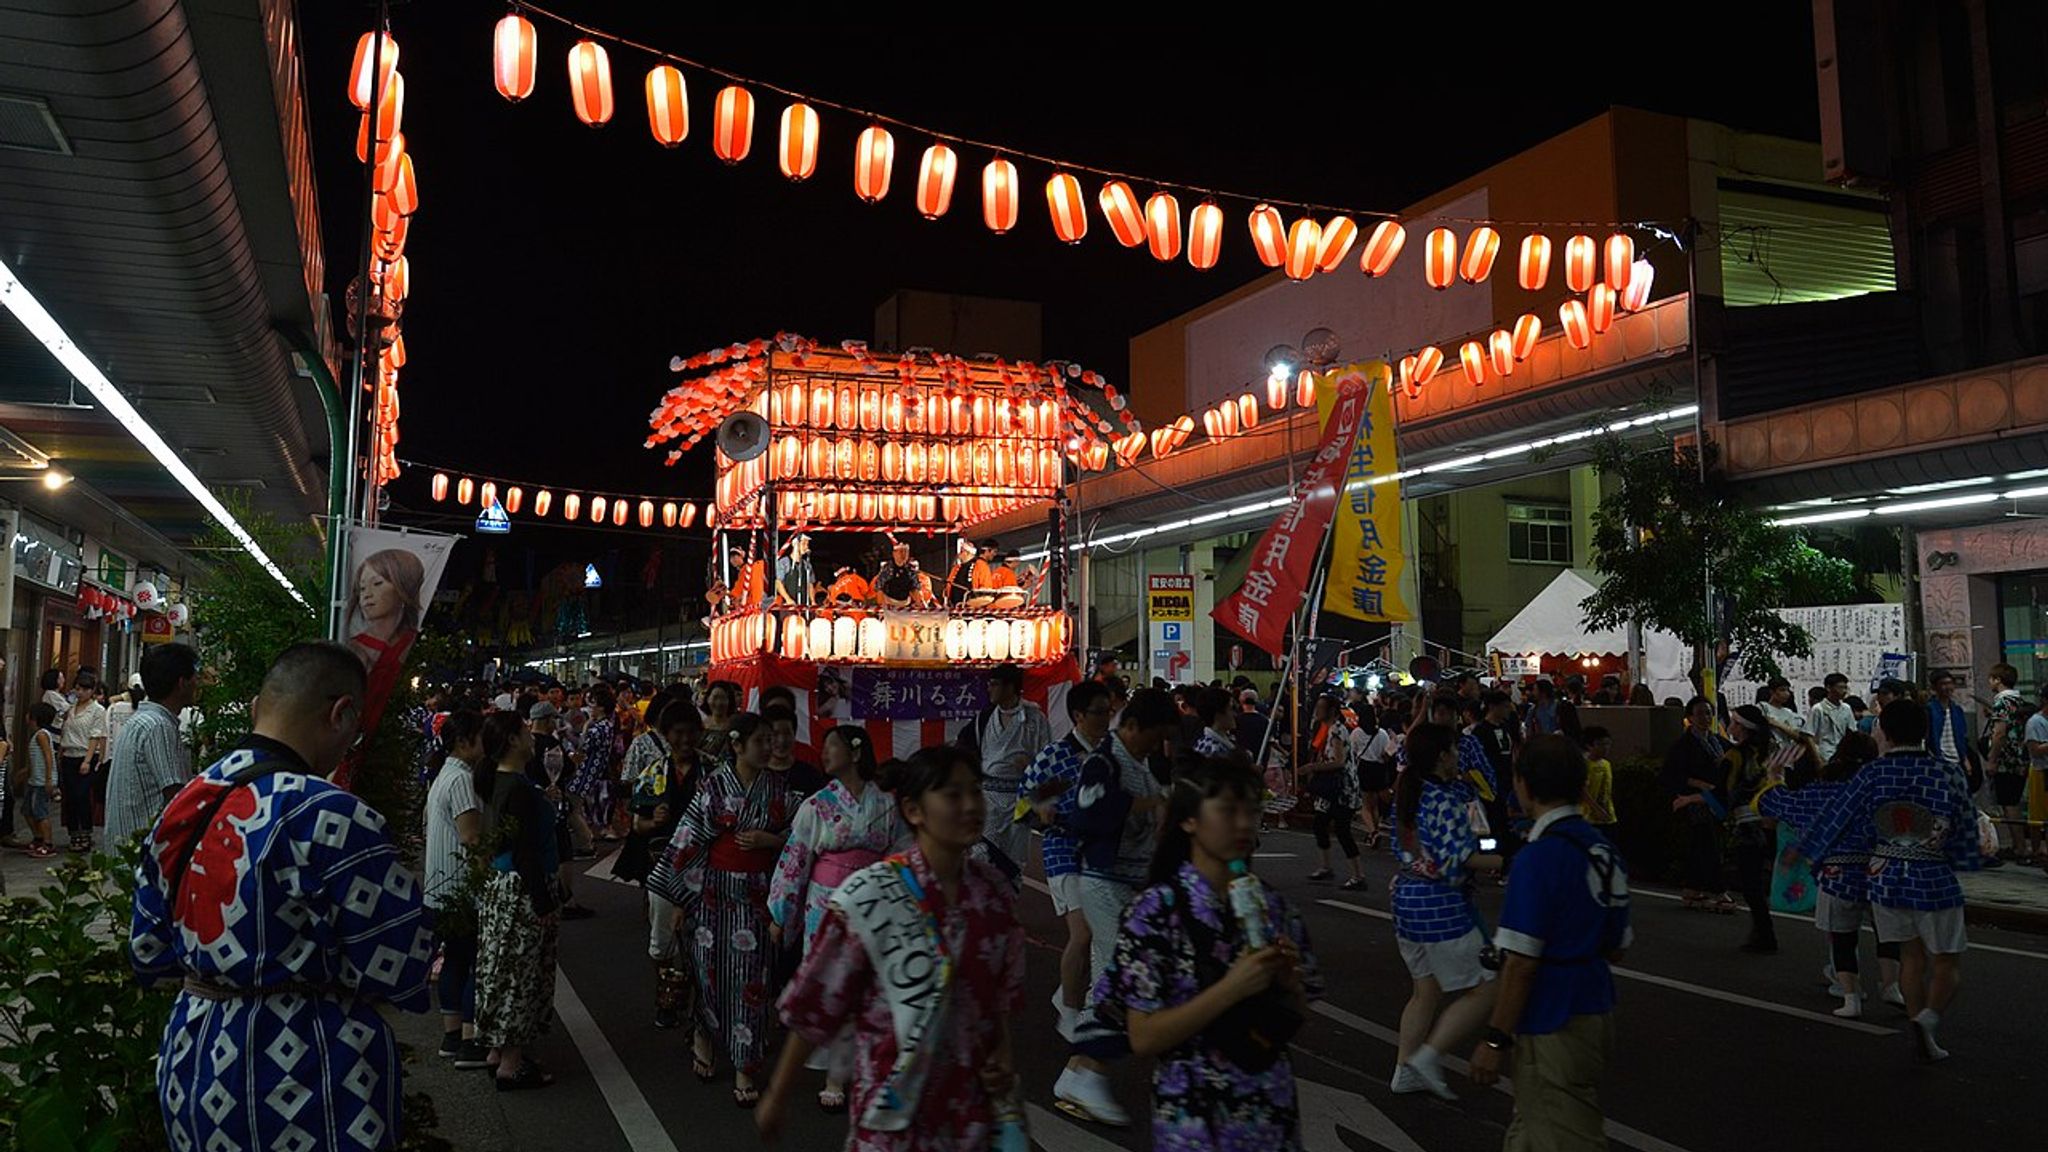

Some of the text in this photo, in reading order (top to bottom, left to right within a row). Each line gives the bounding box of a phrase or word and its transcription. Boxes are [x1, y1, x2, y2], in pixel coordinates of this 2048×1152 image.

[1152, 596, 1190, 607] MEGA
[890, 624, 944, 644] LIXIL
[870, 681, 976, 710] 舞川るみ
